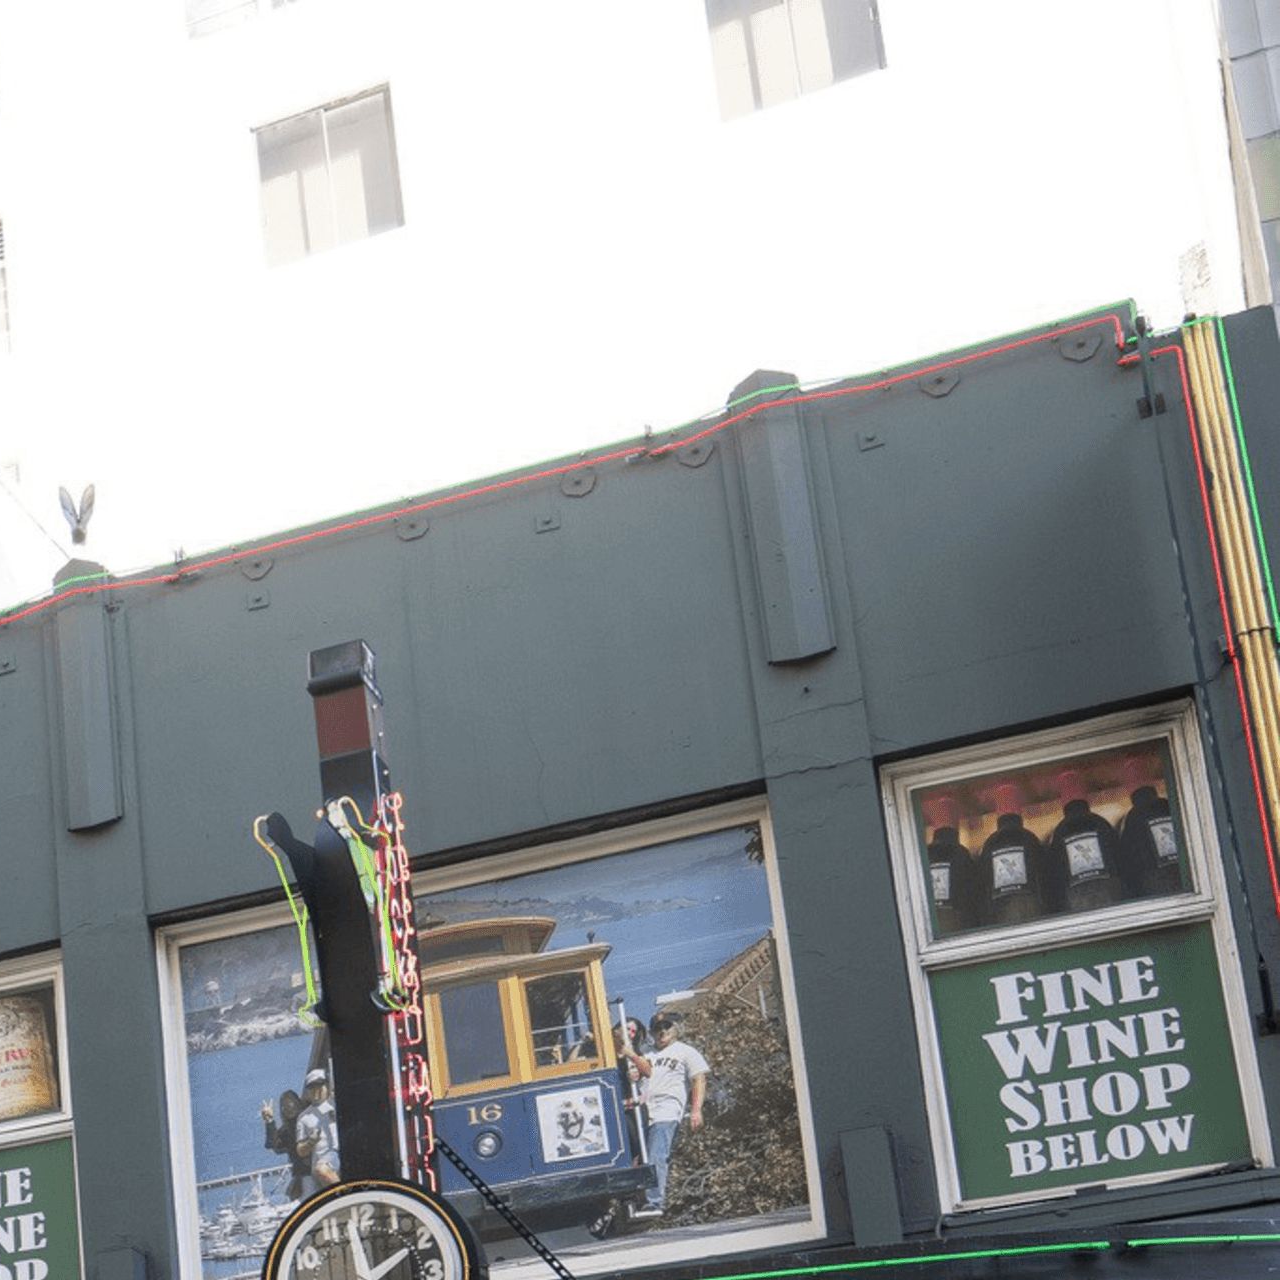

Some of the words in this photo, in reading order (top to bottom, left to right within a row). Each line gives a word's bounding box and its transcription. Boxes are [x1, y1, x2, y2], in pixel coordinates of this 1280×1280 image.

[988, 956, 1159, 1025] FINE
[982, 1007, 1185, 1079] WINE
[999, 1063, 1191, 1133] SHOP
[467, 1103, 503, 1126] 16
[1005, 1114, 1195, 1177] BELOW
[350, 1204, 375, 1227] 12
[323, 1217, 339, 1242] 11
[416, 1226, 433, 1250] 2
[296, 1246, 319, 1270] 10
